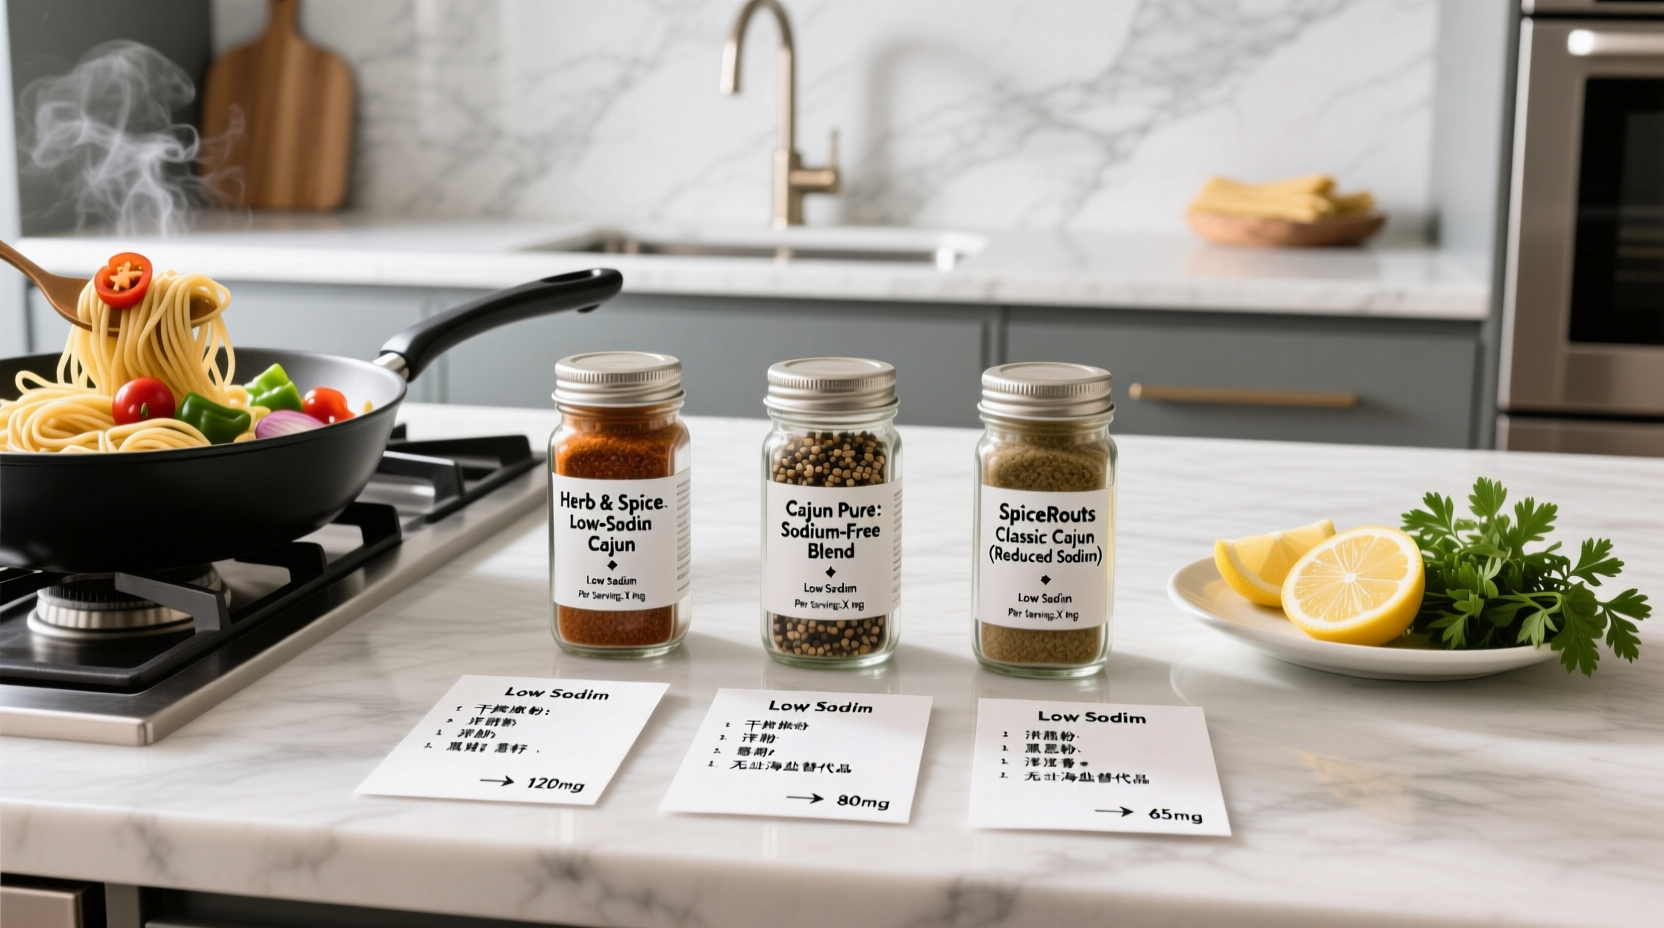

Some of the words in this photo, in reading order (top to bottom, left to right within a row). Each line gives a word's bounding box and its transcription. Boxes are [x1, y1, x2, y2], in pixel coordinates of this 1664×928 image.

[560, 491, 596, 510] Herb
[600, 494, 613, 511] &
[786, 500, 833, 523] Cajun
[838, 502, 882, 518] Pure:
[999, 502, 1096, 526] SpiceRouts
[781, 521, 880, 540] Sodium-Free
[995, 526, 1047, 544] Classic
[1052, 528, 1095, 549] Cajun
[588, 535, 636, 557] Cajun
[808, 542, 855, 559] Blend
[989, 544, 1053, 564] (Reduced
[804, 582, 823, 593] Low
[1018, 592, 1039, 603] Low
[504, 686, 545, 698] Low
[768, 700, 810, 713] Low
[1038, 710, 1080, 723] Low
[527, 777, 586, 794] 120mg
[836, 794, 890, 811] 80mg
[1148, 808, 1203, 824] 65mg
